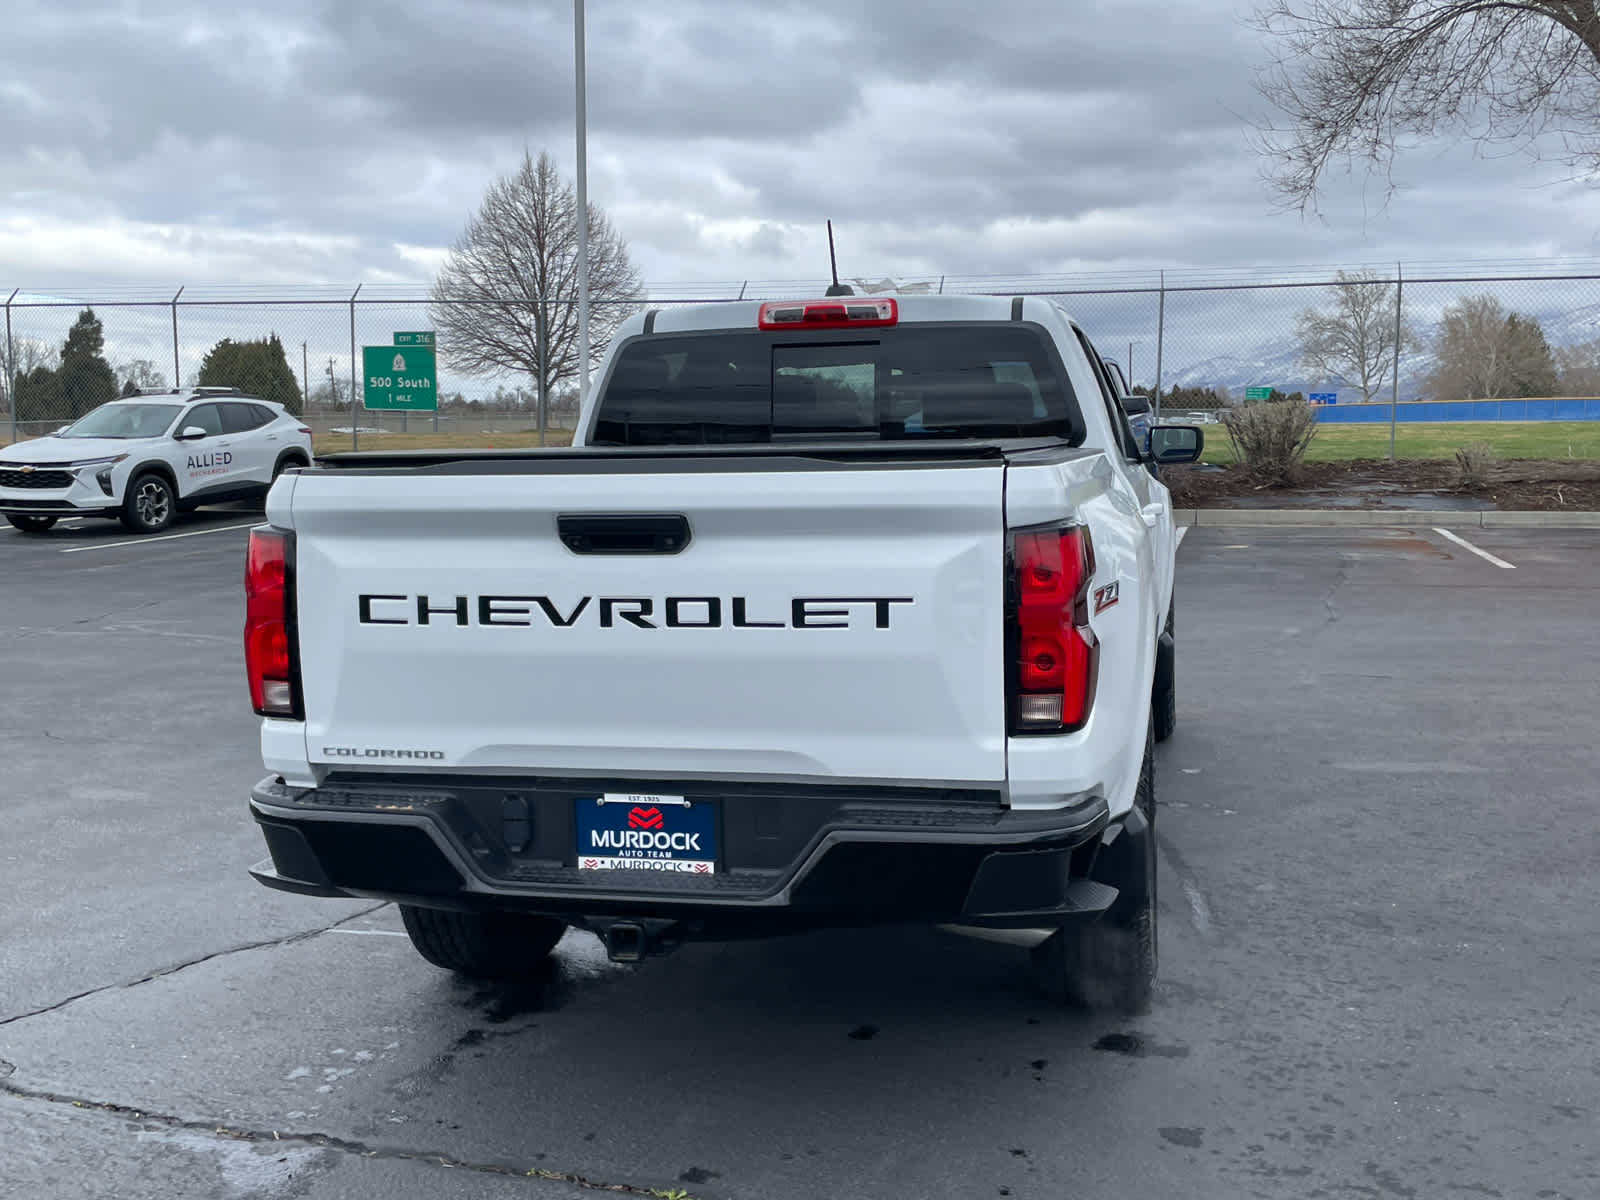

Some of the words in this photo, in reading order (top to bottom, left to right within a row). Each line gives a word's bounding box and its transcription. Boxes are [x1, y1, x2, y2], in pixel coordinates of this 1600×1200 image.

[398, 335, 412, 343] EXIT
[370, 376, 392, 388] 500
[397, 376, 430, 388] South
[396, 394, 412, 402] MILE
[187, 452, 232, 469] ALLIED
[1094, 580, 1120, 616] Z71
[358, 594, 914, 630] CHEVROLET
[322, 747, 446, 760] COLORADO
[591, 829, 701, 851] MURDOCK
[618, 850, 644, 858] AUTO
[647, 851, 673, 859] TEAM
[610, 859, 683, 873] MURDOCK
